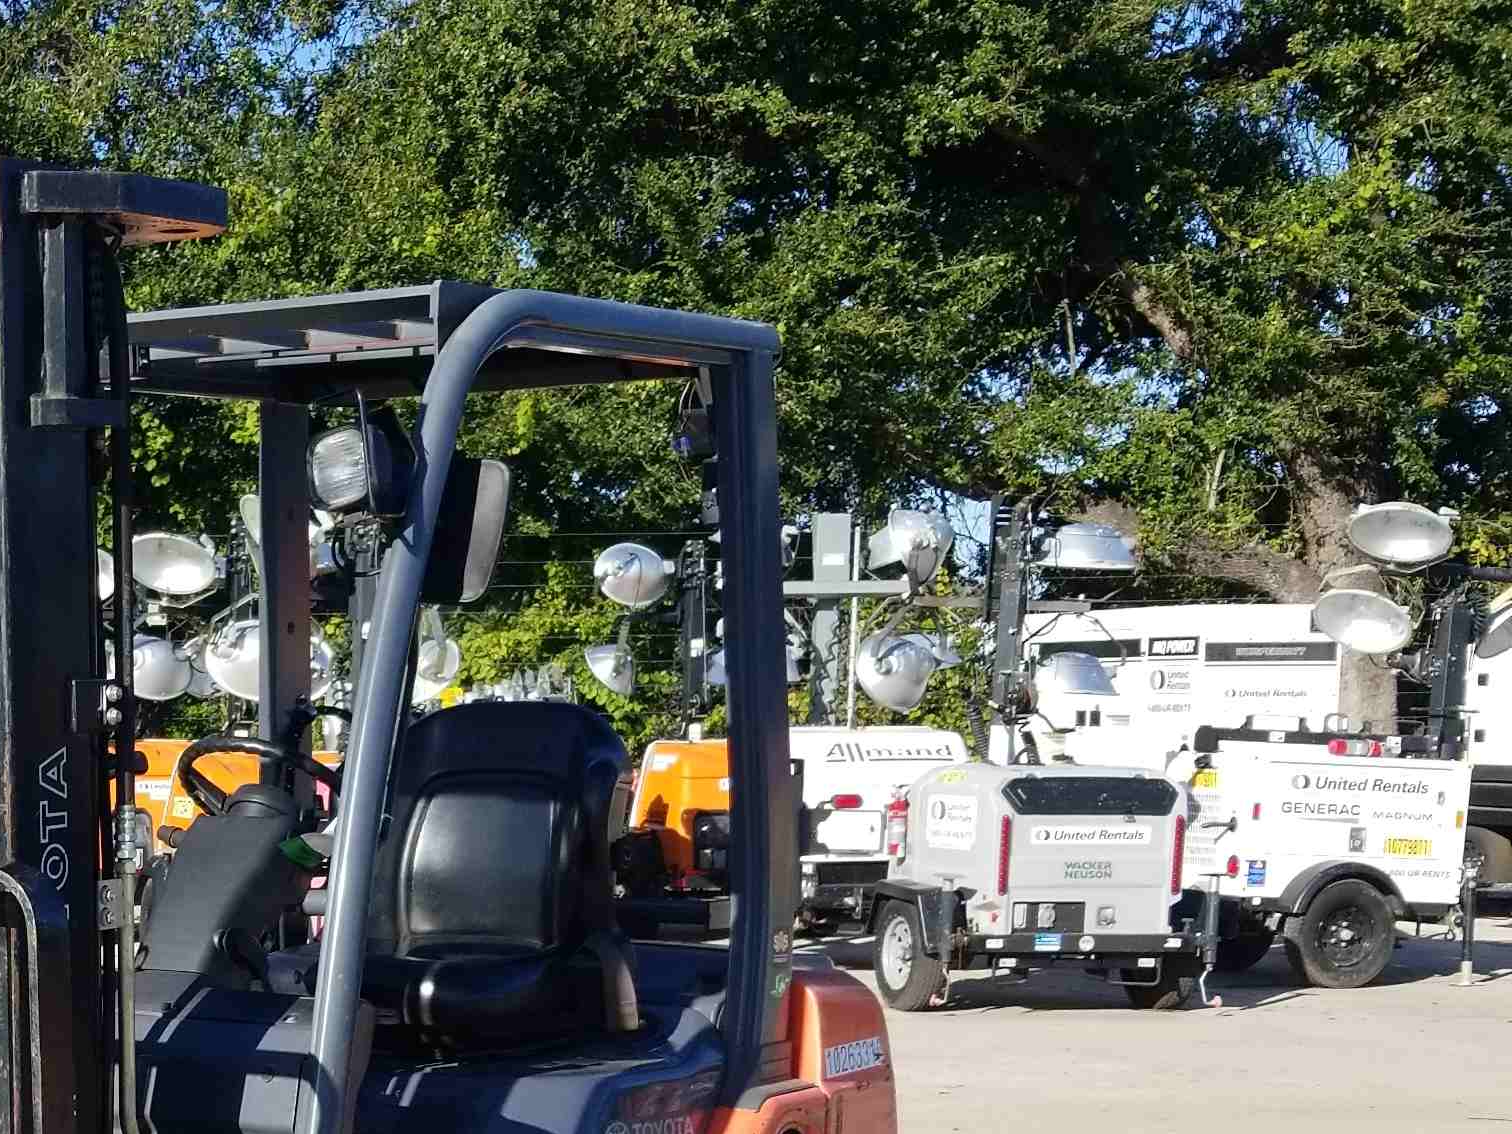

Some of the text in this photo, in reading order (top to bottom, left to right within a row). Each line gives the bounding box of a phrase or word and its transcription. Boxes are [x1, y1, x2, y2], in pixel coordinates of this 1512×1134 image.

[826, 743, 953, 762] Allmand
[1316, 776, 1429, 795] United Rentals
[1281, 801, 1433, 822] GENERAC MAGNUM
[1054, 829, 1145, 840] United Rentals
[1064, 861, 1113, 870] WACKER
[1064, 870, 1113, 880] NEUSON
